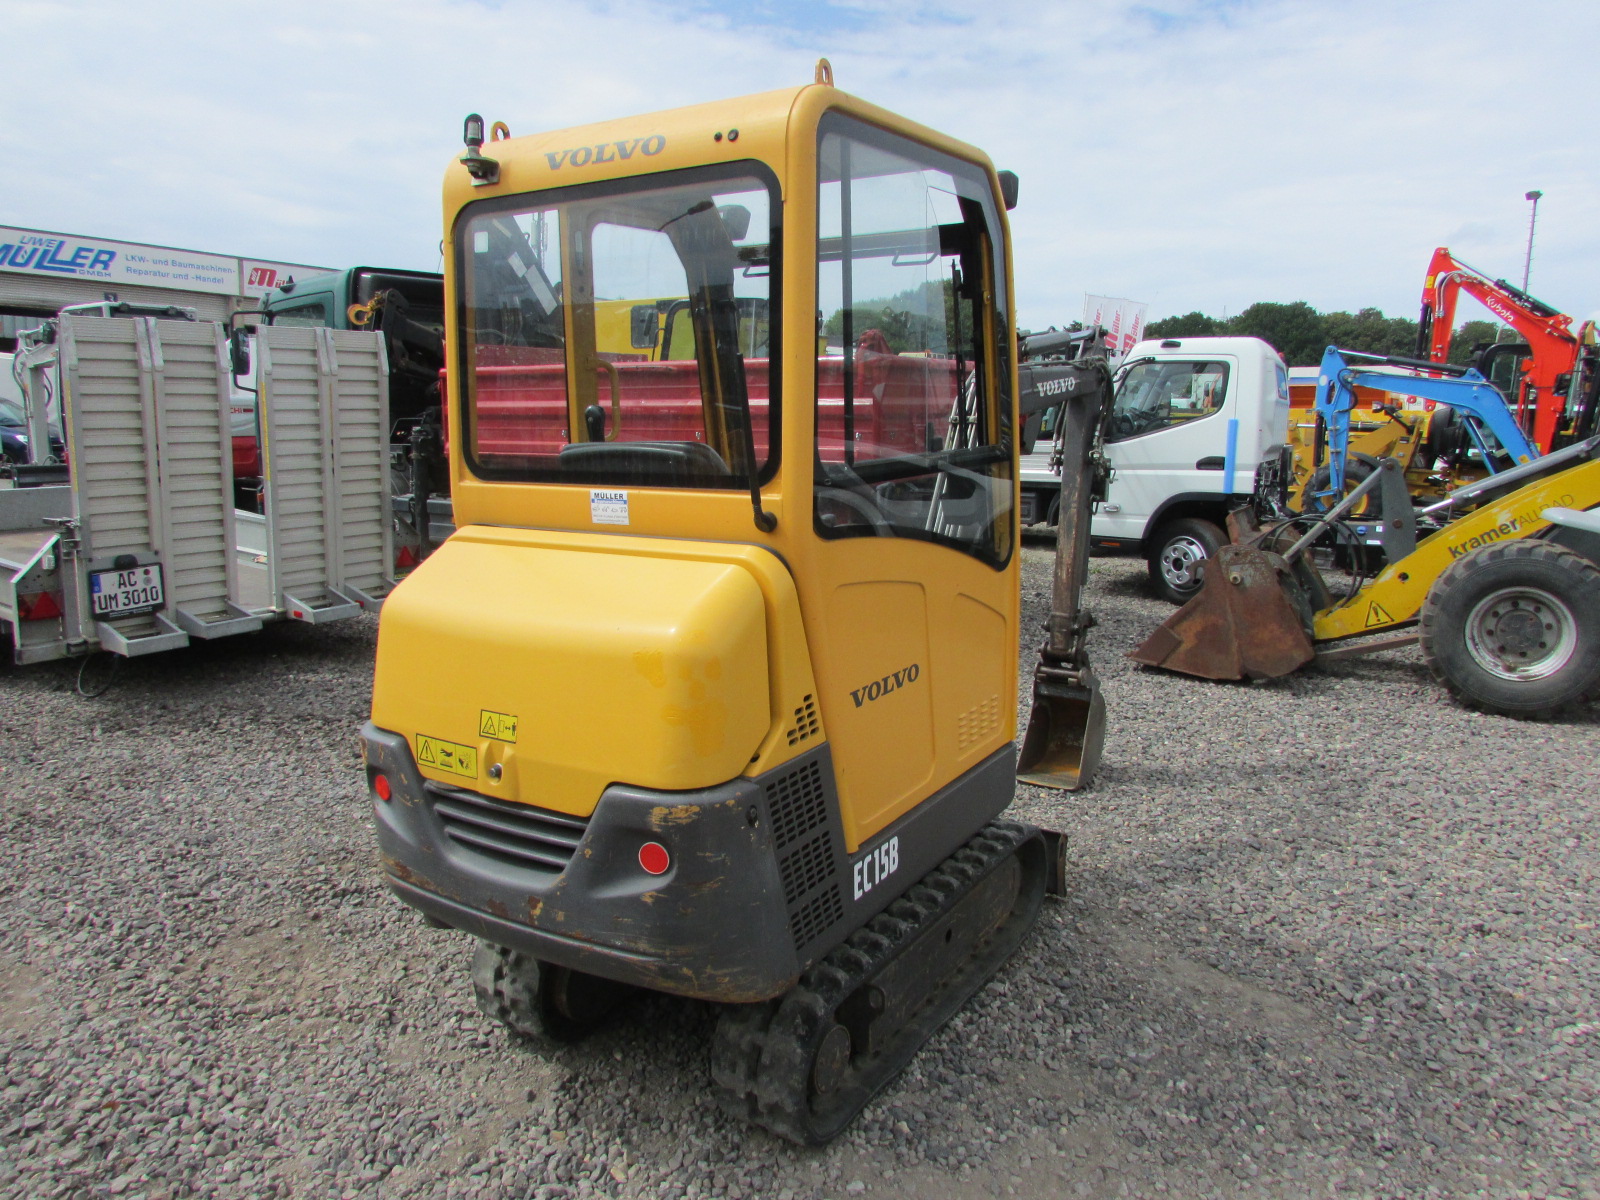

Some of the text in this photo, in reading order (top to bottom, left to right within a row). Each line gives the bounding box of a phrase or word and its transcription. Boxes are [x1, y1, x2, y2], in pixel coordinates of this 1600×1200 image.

[544, 134, 667, 171] VOLVO
[125, 254, 236, 274] LKW- und Baumaschinen-
[126, 266, 224, 285] Reparatur und -Handel
[1486, 295, 1514, 322] Kubota
[1037, 376, 1076, 397] VOLVO
[1447, 517, 1519, 559] kramer
[118, 571, 137, 589] AC
[98, 586, 159, 611] UM 3010
[849, 663, 920, 709] VOLVO
[853, 835, 899, 901] EC15B
